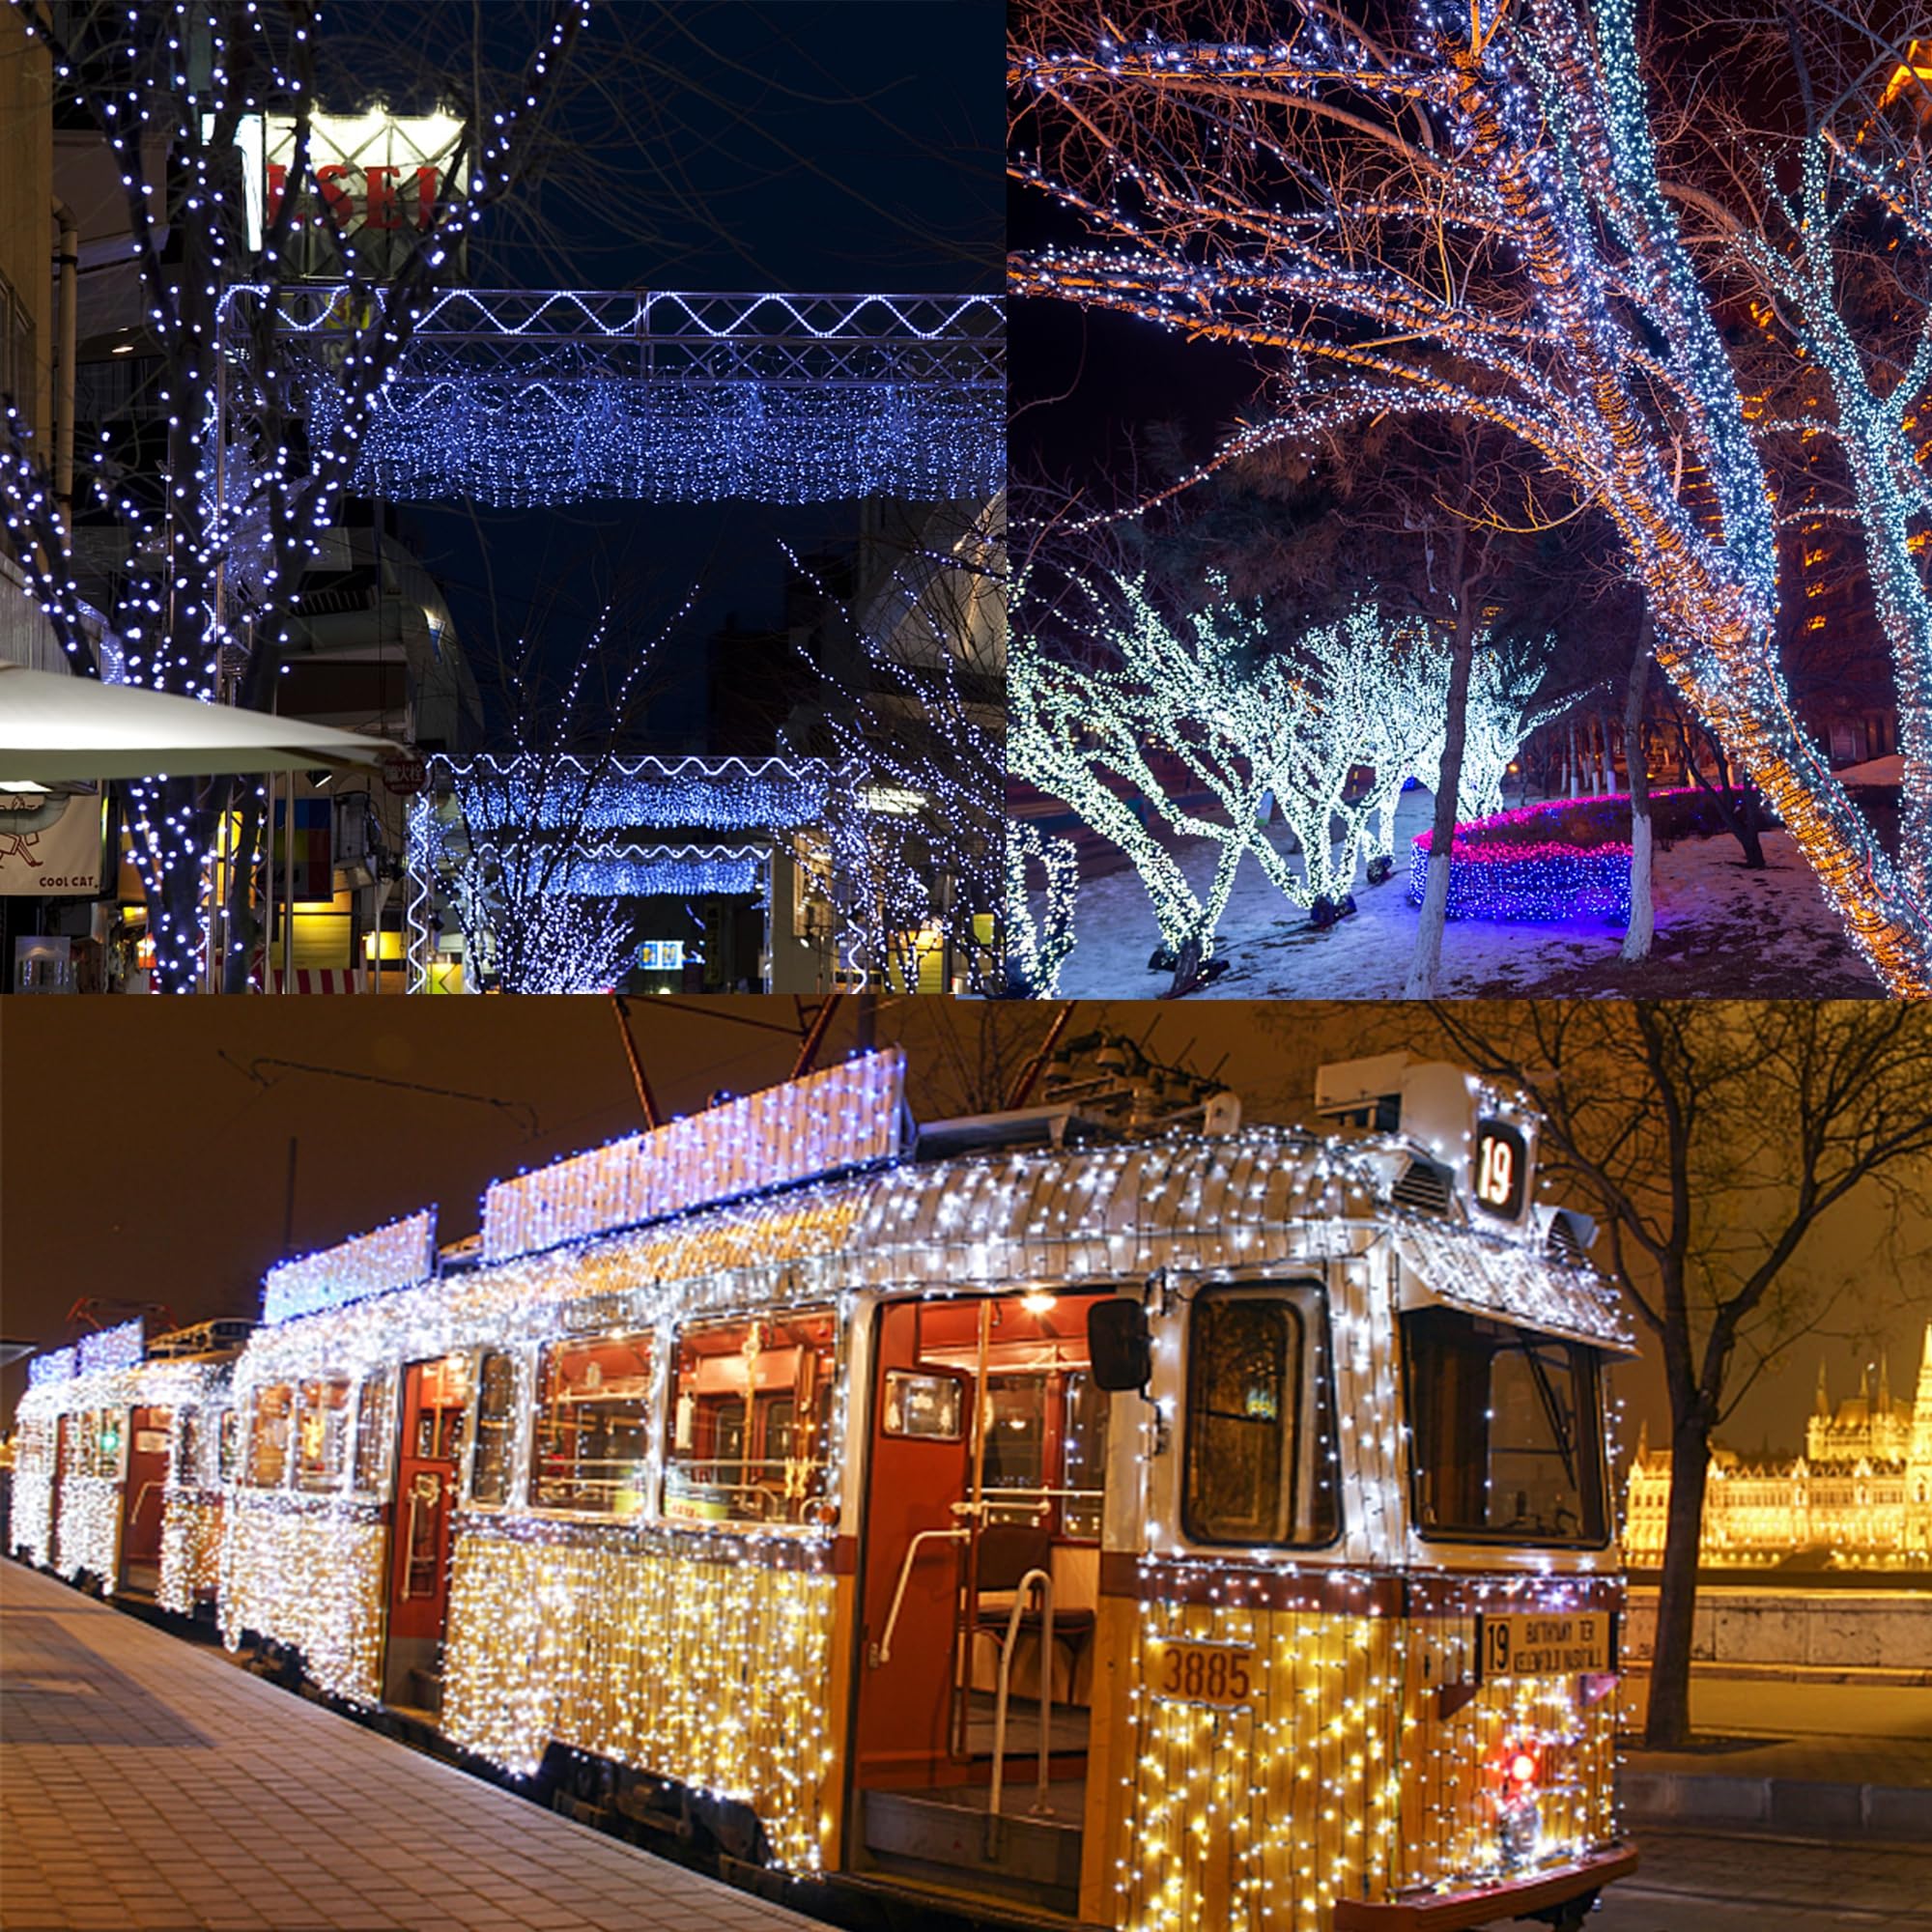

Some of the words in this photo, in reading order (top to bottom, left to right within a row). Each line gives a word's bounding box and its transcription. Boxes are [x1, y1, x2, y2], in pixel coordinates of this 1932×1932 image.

[39, 876, 69, 888] COOL
[1478, 1136, 1514, 1206] 19
[1488, 1623, 1509, 1670] 19
[1163, 1647, 1250, 1699] 3885
